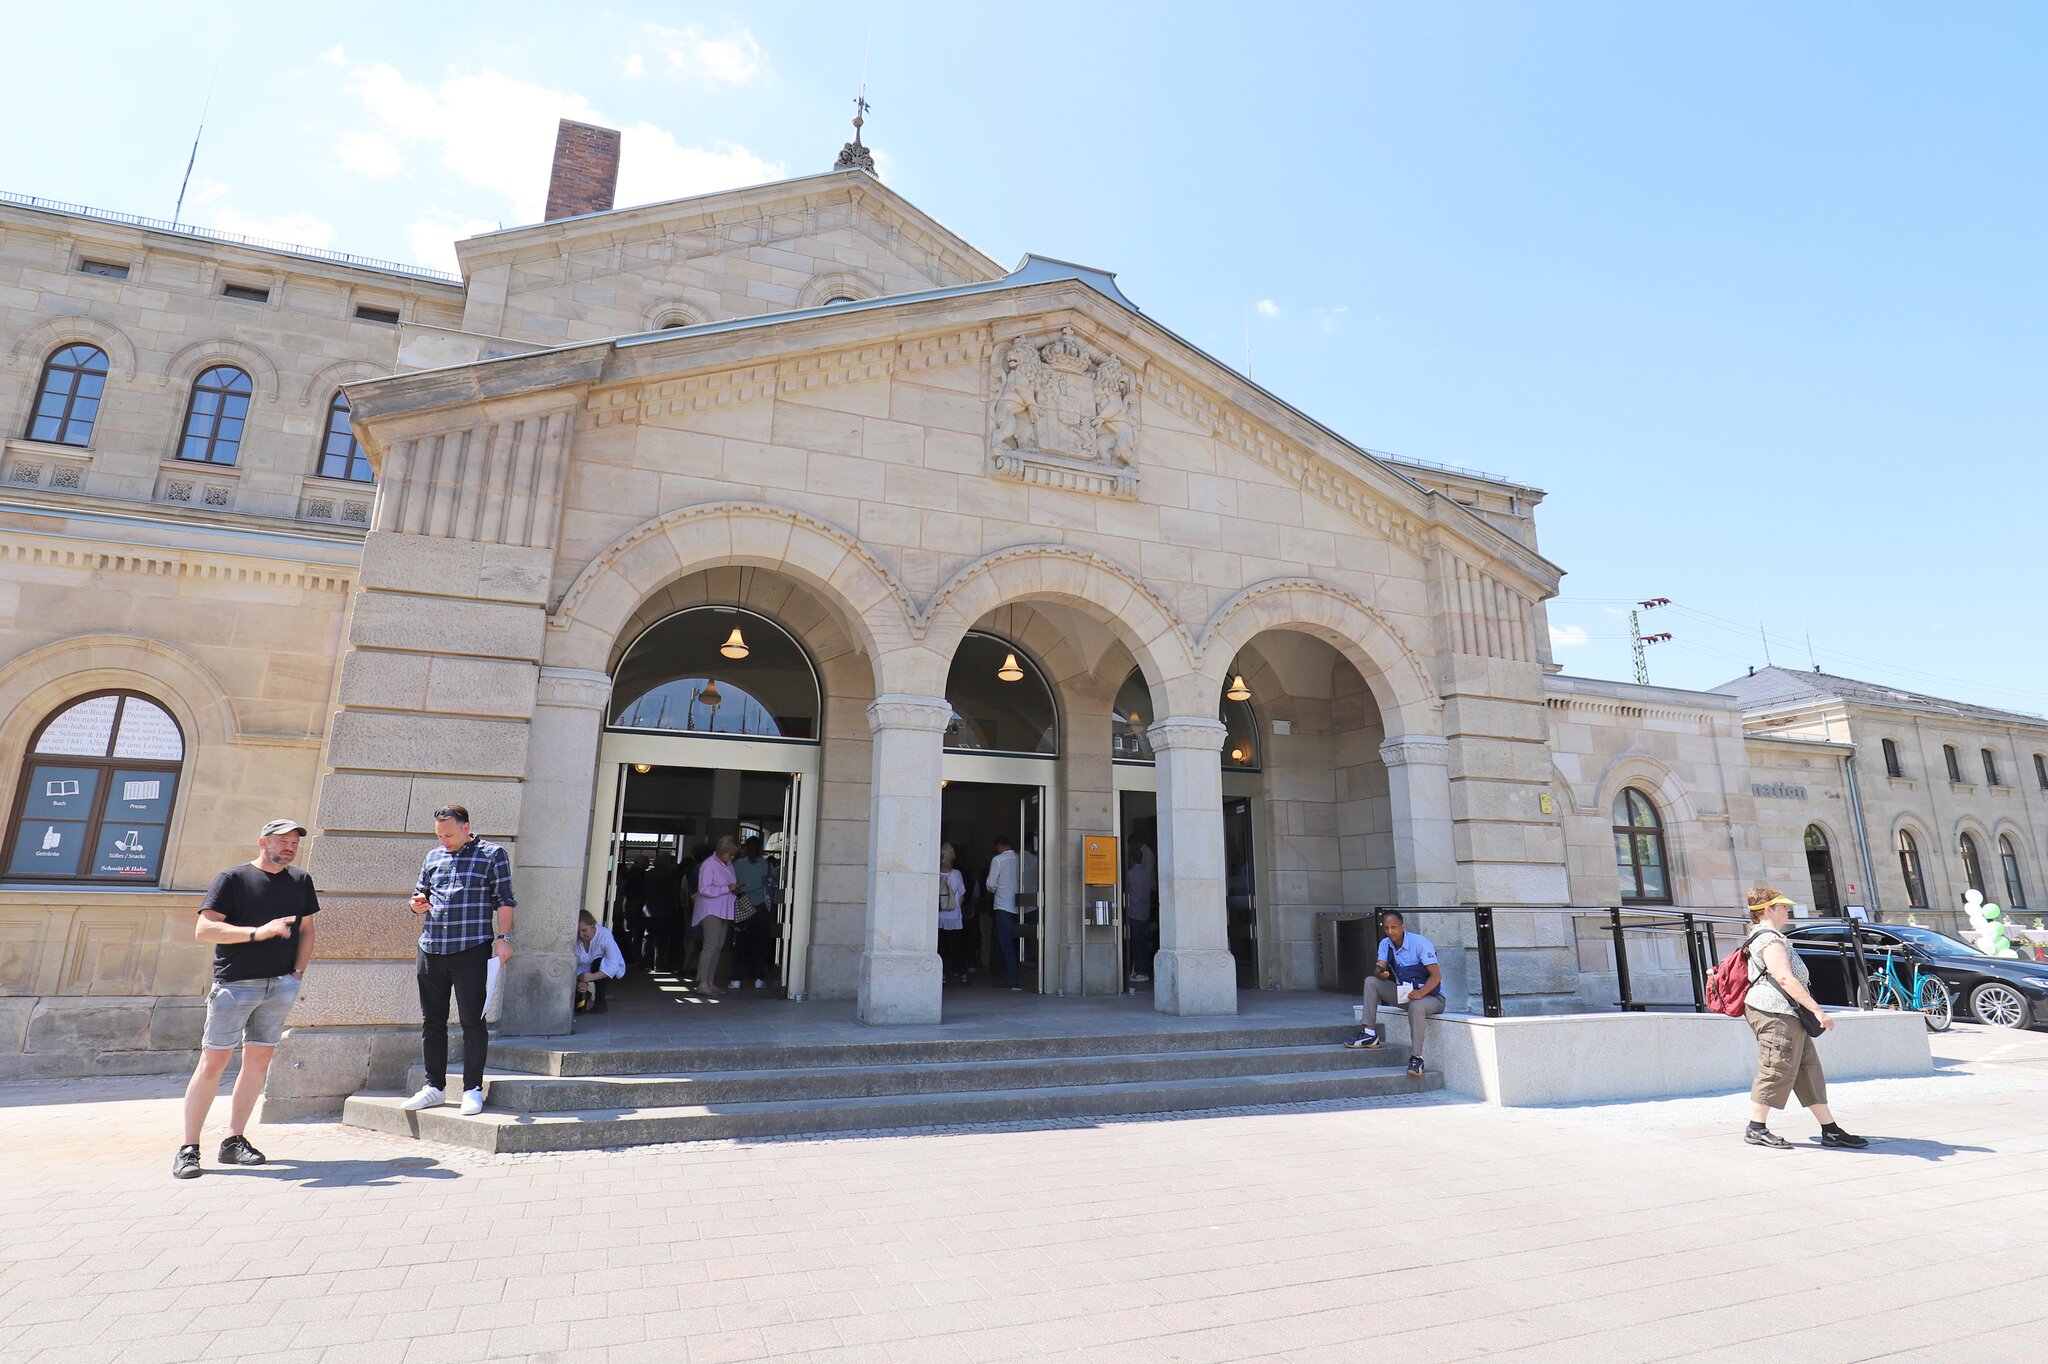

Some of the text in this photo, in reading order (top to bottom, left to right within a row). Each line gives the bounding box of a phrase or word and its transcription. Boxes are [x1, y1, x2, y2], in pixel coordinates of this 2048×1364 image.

[127, 711, 148, 719] Presse
[59, 729, 86, 737] Schmitt
[152, 735, 174, 743] Presse
